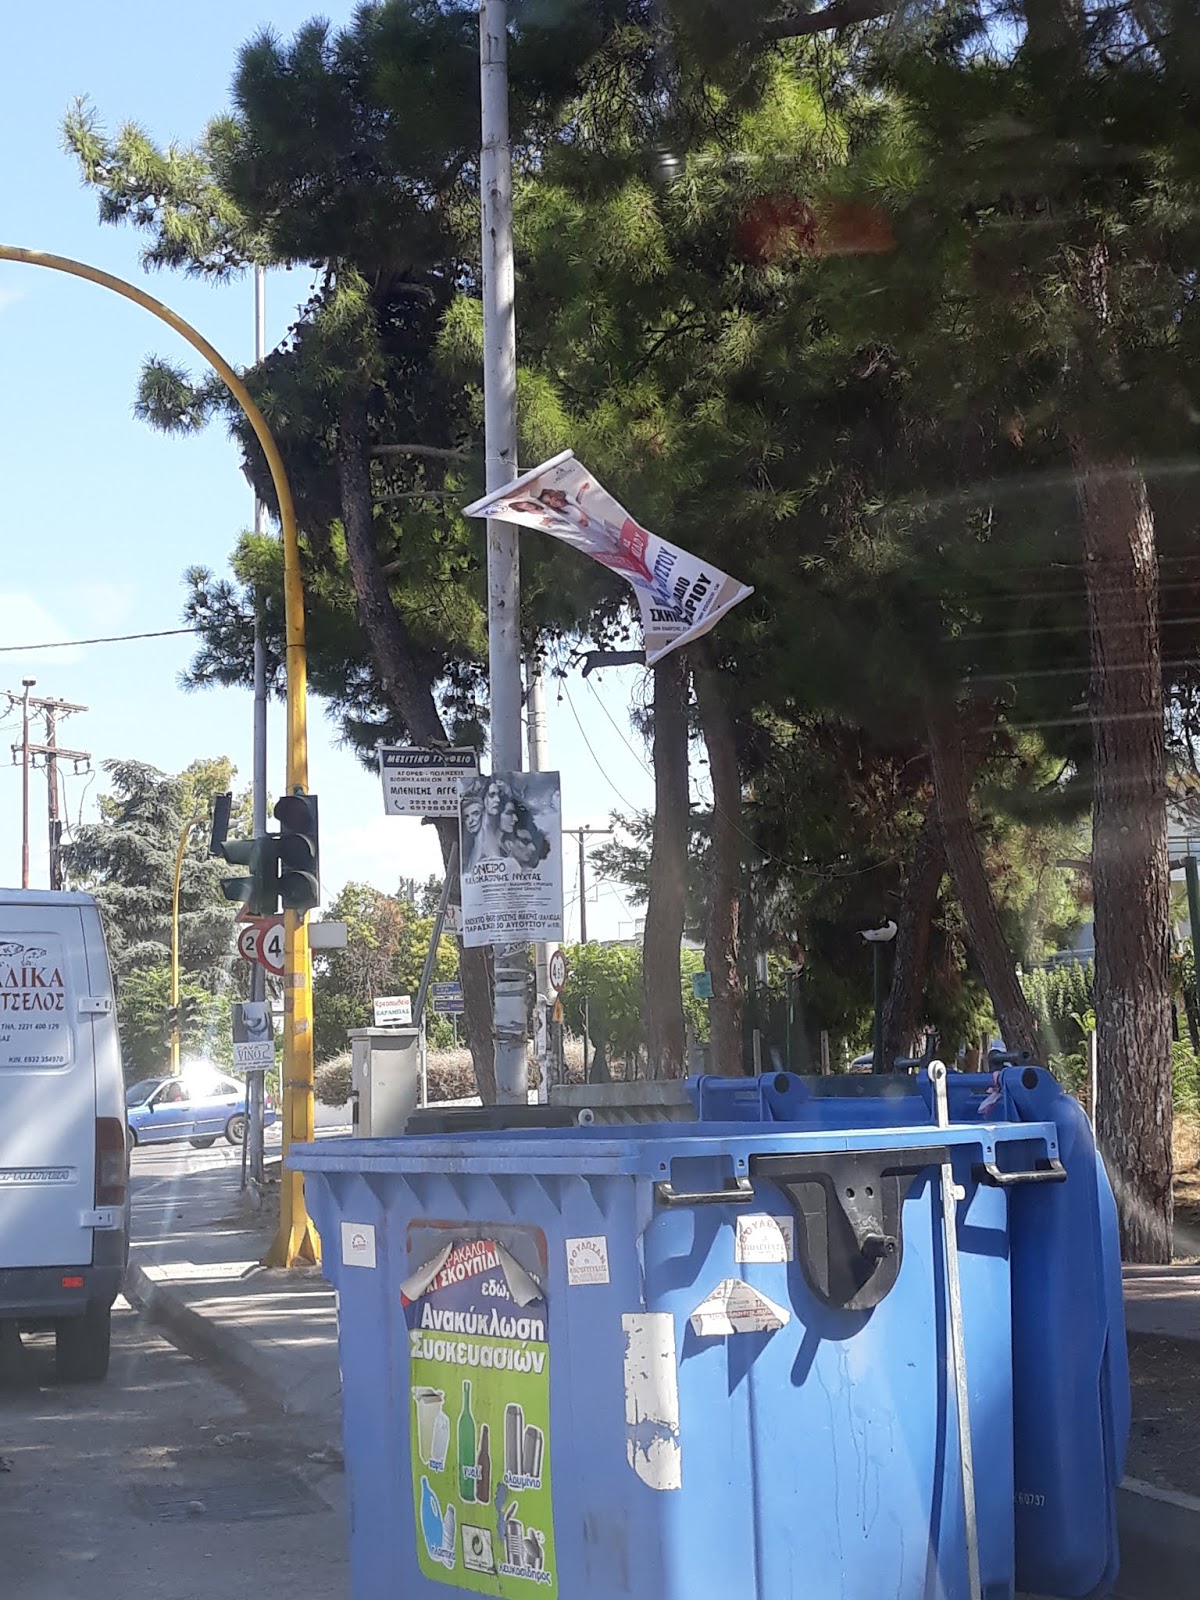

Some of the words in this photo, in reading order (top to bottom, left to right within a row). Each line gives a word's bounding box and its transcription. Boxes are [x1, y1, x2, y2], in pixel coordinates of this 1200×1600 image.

[387, 755, 430, 763] ΜΕΣΙΤΙΚΟ
[390, 787, 432, 795] ΜΠΕΝΙΣΗΣ
[512, 873, 541, 881] ΝΥΧΤΑΣ
[440, 1251, 500, 1288] ΣΚΟΥΠΙΔΙ
[421, 1302, 545, 1341] Ανακύκλωση
[410, 1331, 547, 1374] Συσκευασιών
